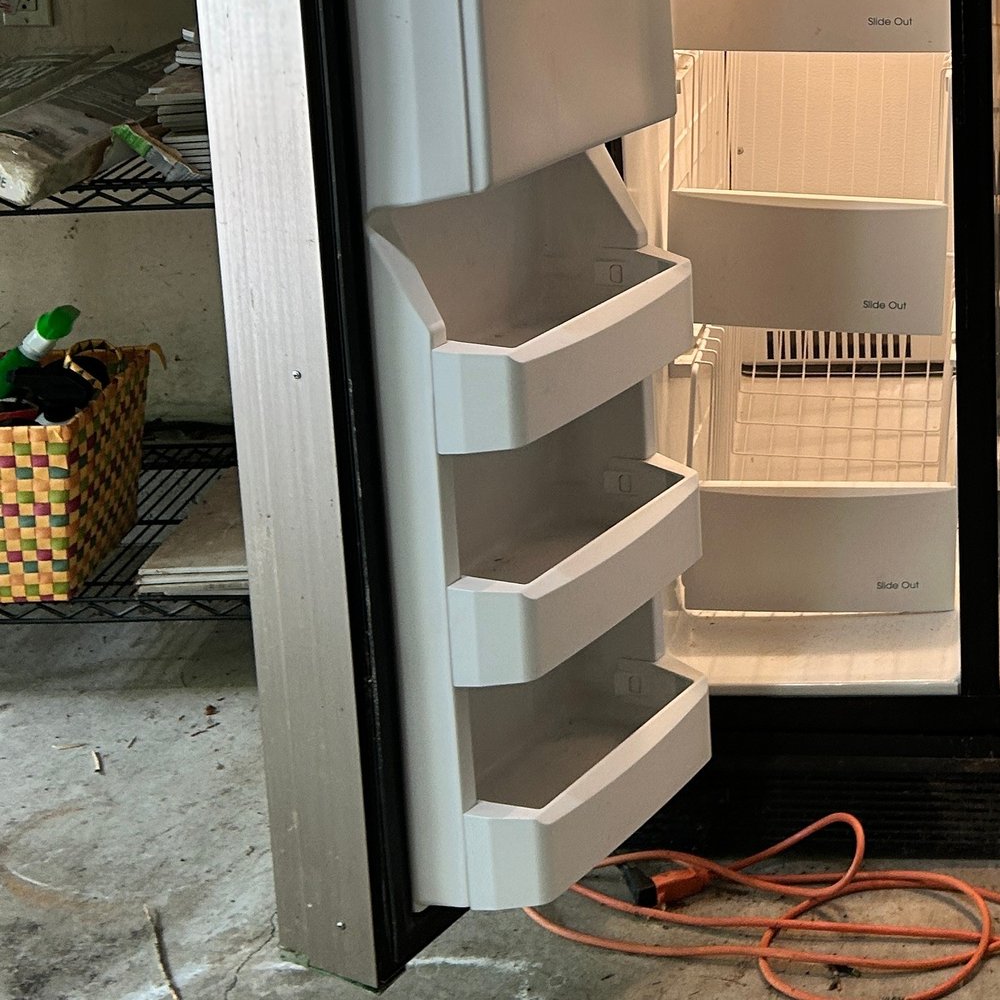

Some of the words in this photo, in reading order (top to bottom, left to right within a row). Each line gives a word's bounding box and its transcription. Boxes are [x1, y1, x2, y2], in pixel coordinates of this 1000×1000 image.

[867, 16, 892, 26] Slide
[894, 17, 913, 26] Out
[863, 300, 886, 310] Slide
[888, 301, 908, 311] Out
[876, 580, 899, 590] Slide
[901, 581, 920, 590] Out
